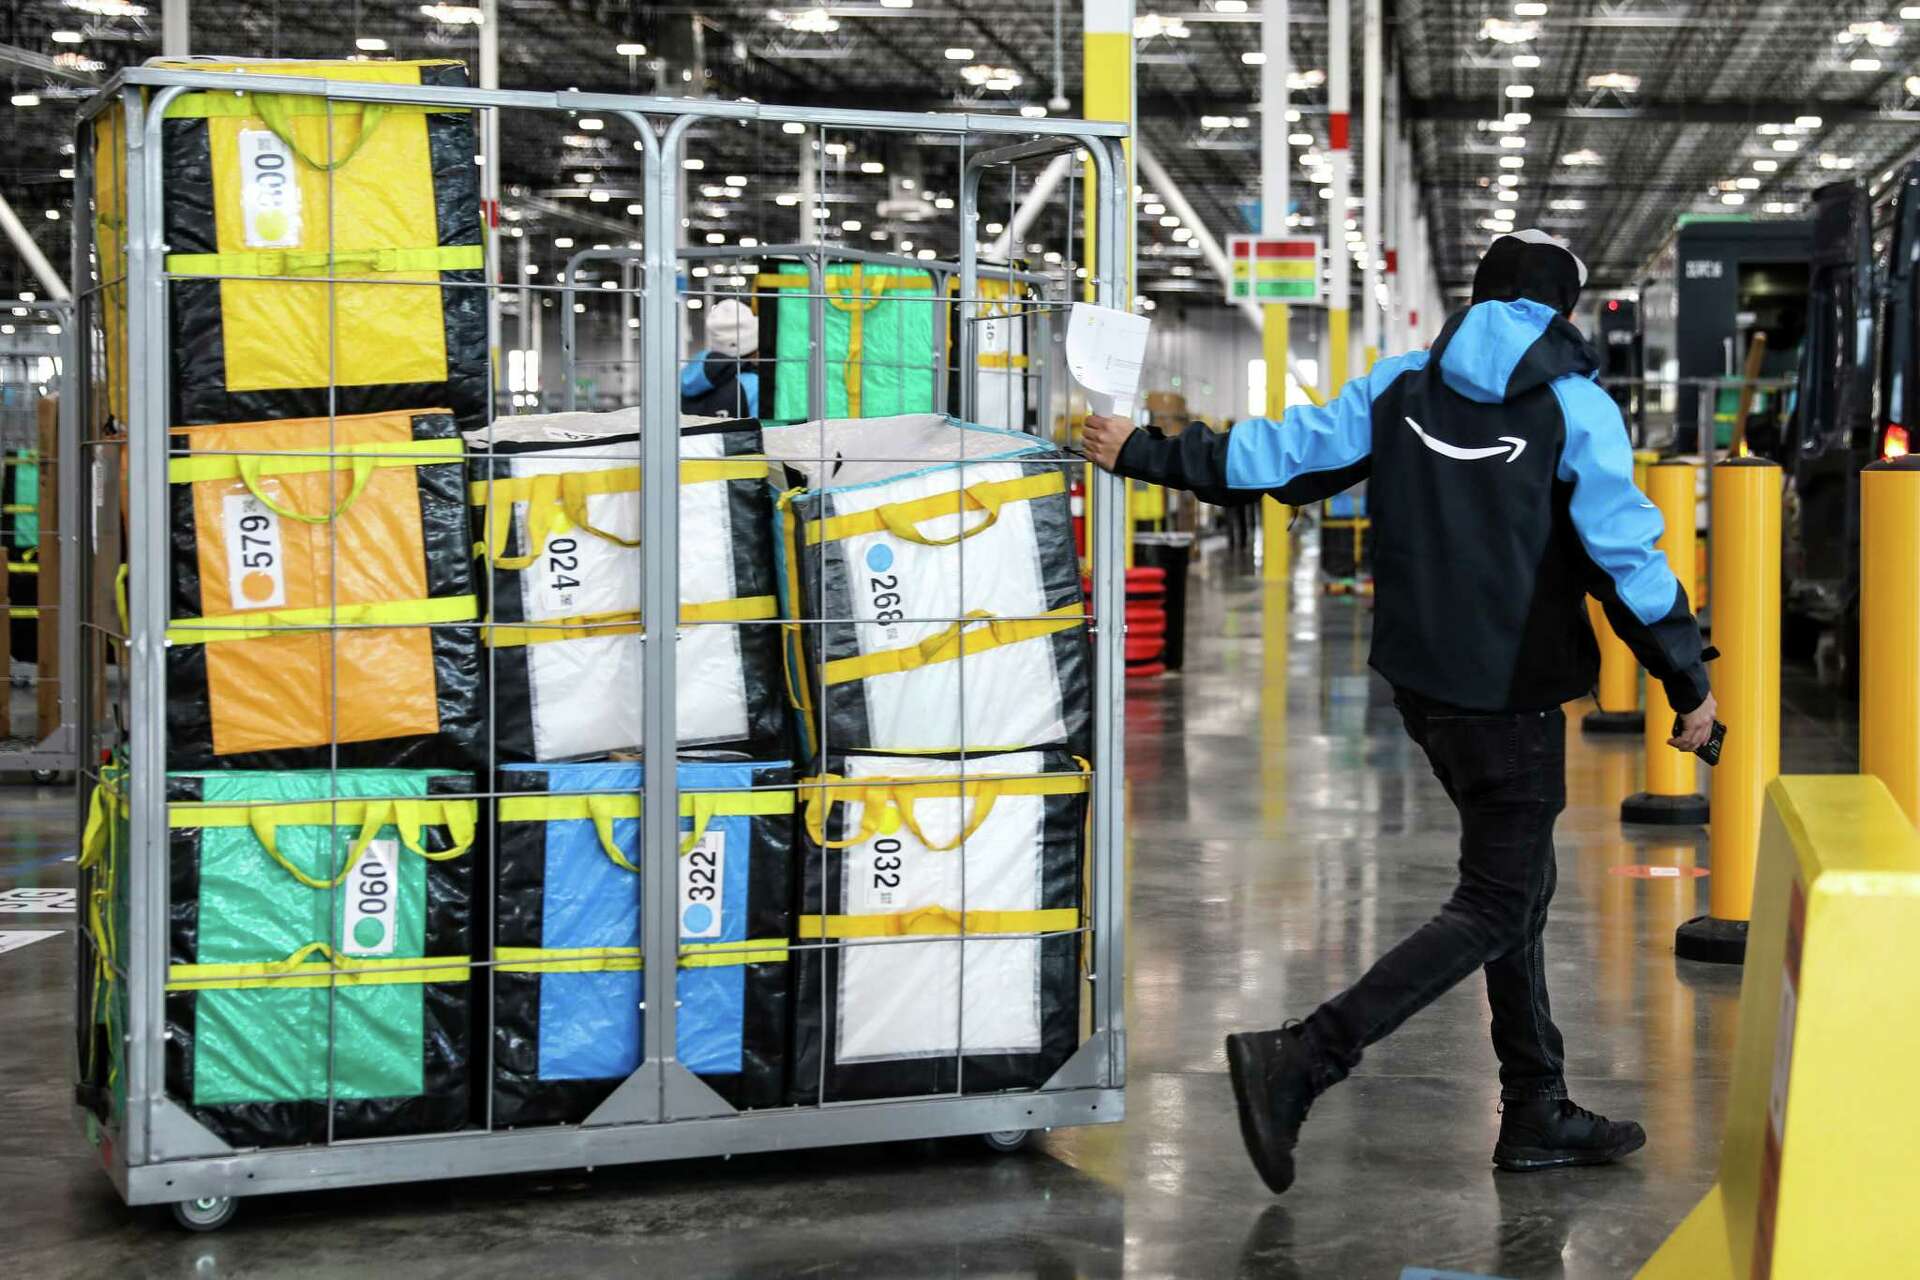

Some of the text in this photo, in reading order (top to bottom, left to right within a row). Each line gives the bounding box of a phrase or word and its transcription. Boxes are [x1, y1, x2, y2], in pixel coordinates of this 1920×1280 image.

[254, 153, 286, 207] 00
[240, 515, 273, 568] 579
[549, 538, 580, 590] 024
[871, 575, 903, 626] 268
[359, 862, 388, 914] 060
[689, 852, 716, 901] 322
[874, 839, 901, 888] 032
